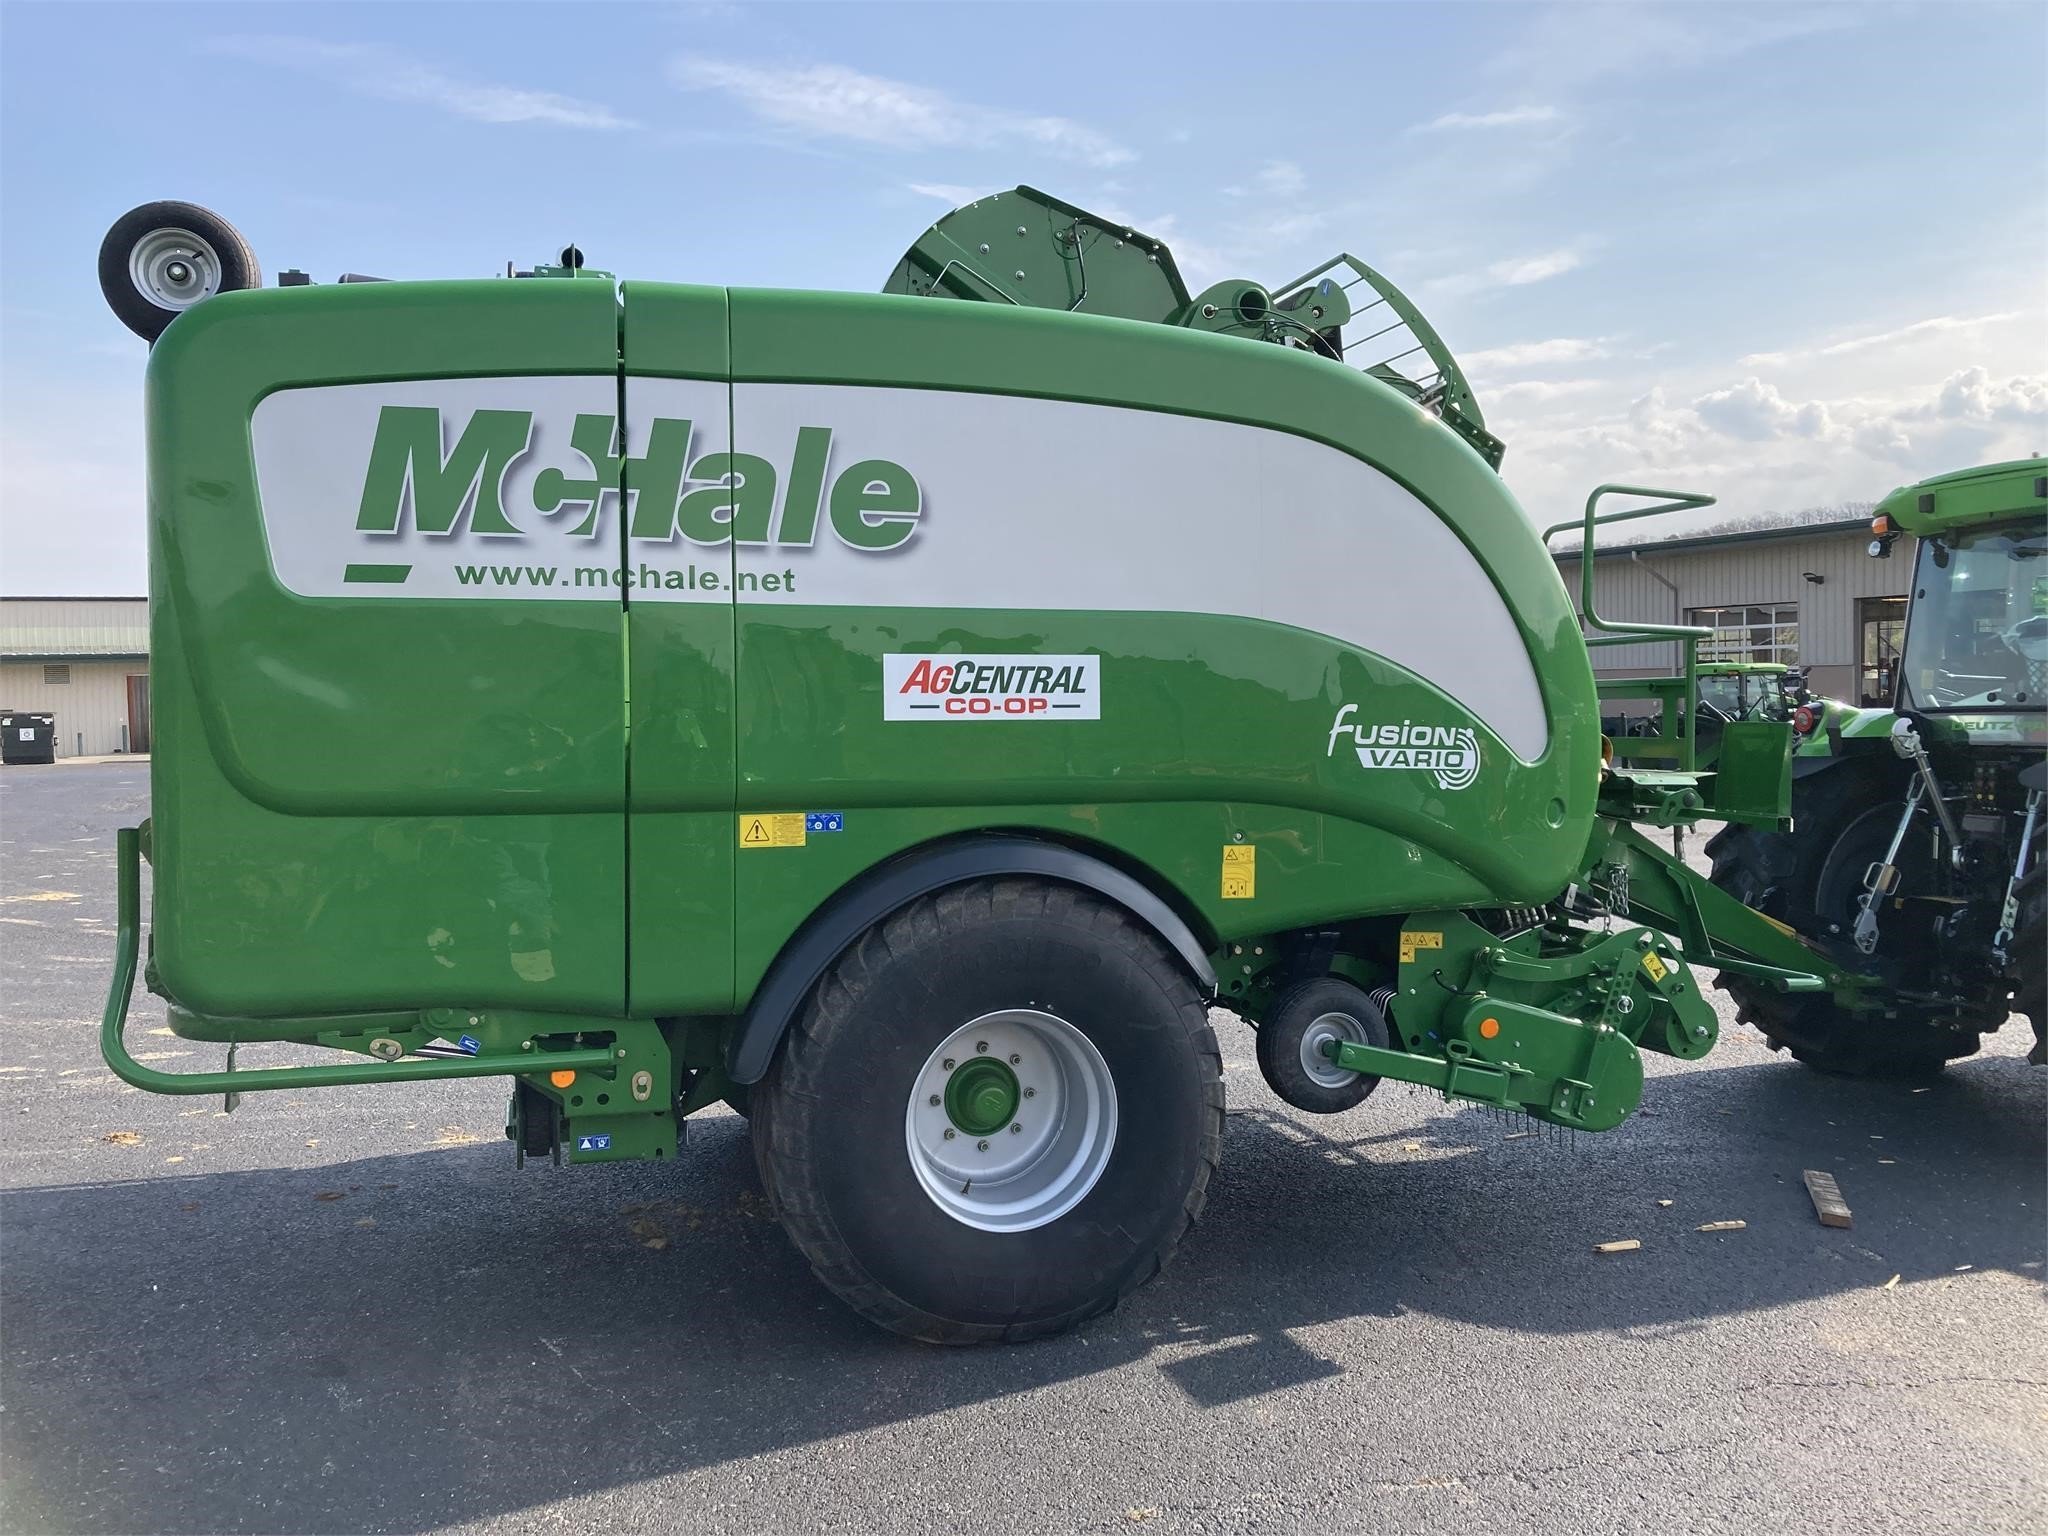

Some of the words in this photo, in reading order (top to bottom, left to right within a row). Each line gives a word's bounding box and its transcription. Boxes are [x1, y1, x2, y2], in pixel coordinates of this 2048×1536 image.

[355, 405, 921, 550] McHale
[455, 563, 796, 592] www.mchale.net
[945, 698, 1048, 714] CO-OP
[1952, 720, 2013, 732] DEUTZ
[1369, 749, 1464, 768] VARIO
